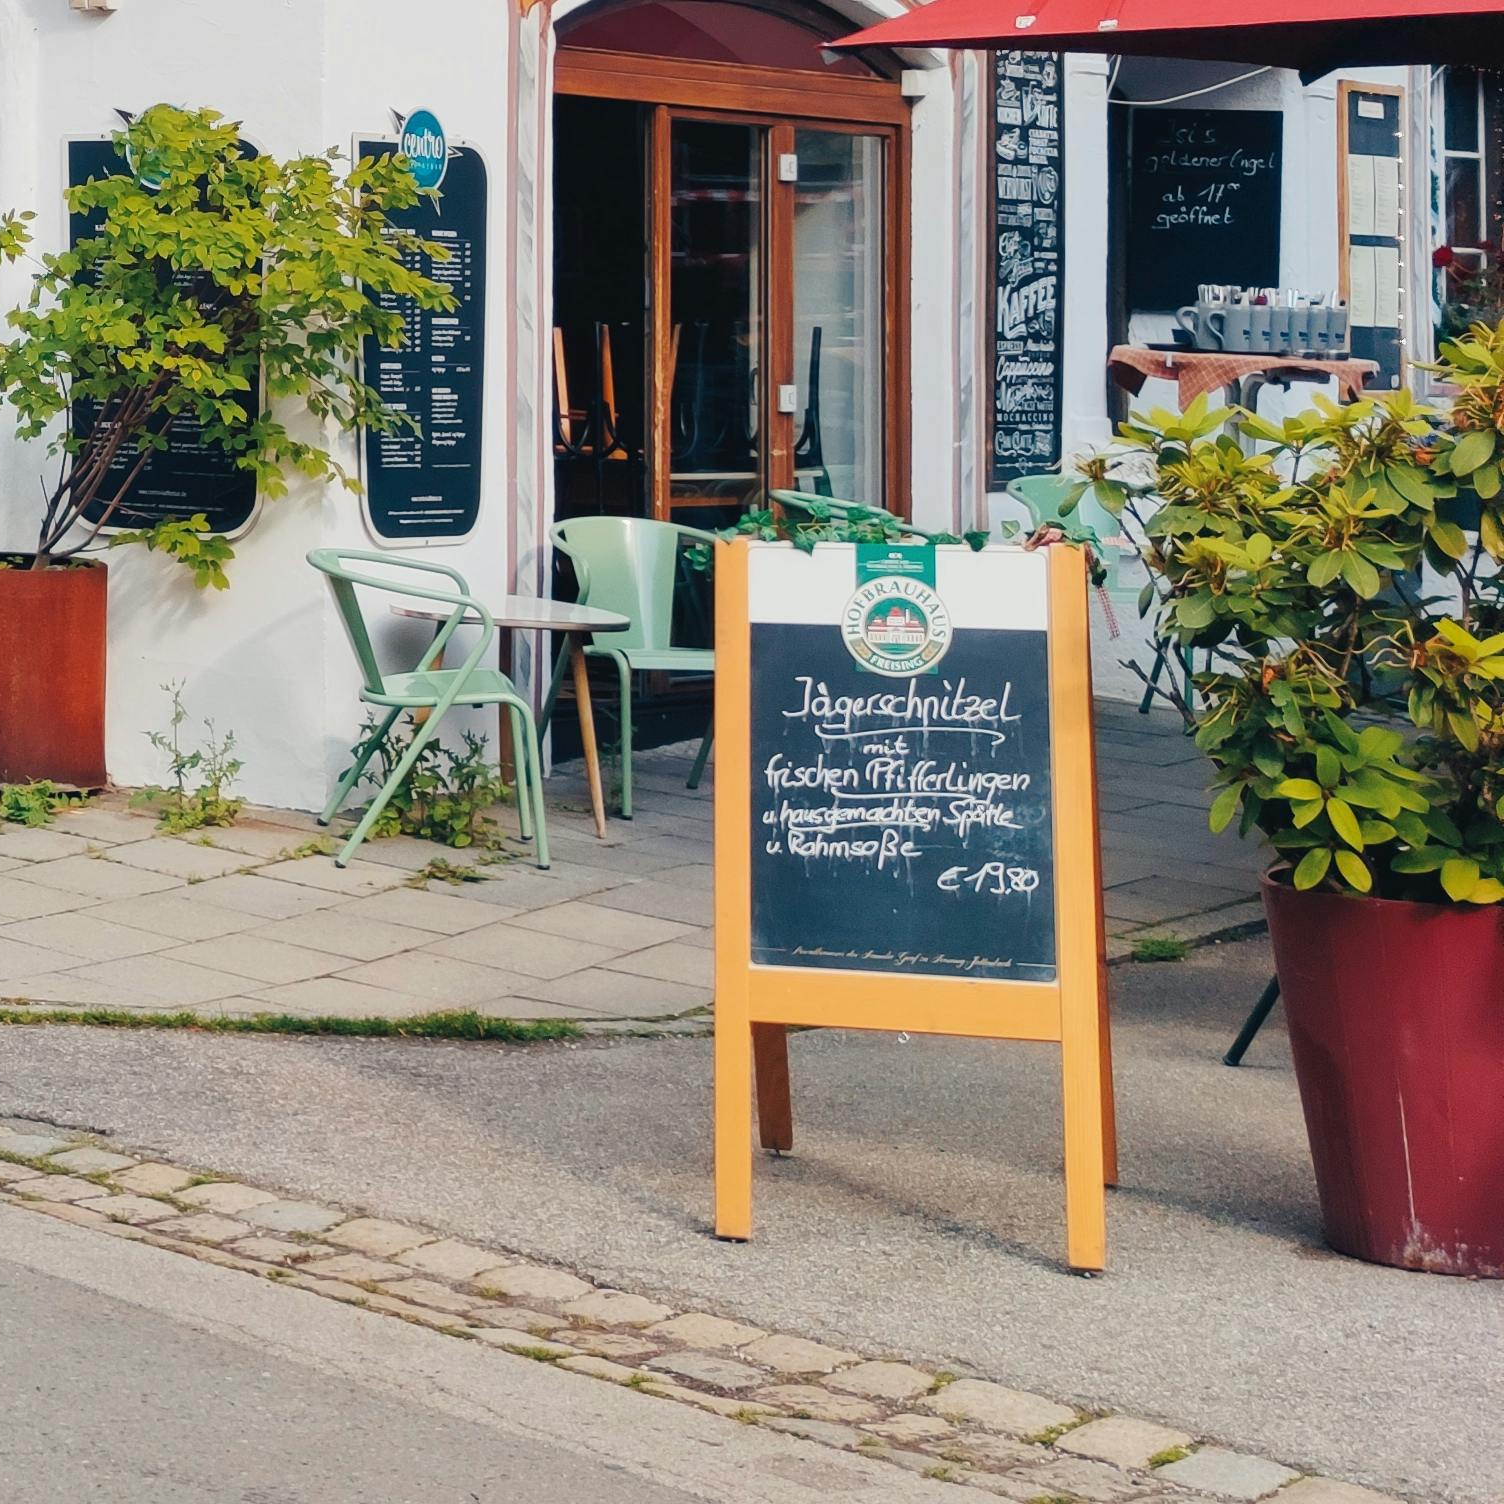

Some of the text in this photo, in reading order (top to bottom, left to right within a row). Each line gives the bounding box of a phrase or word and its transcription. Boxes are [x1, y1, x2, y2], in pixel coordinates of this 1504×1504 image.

[1161, 185, 1185, 202] ab
[996, 276, 1056, 340] KAFFEE
[870, 654, 924, 671] FREISING
[782, 676, 1022, 730] Jägerschnitzel
[863, 735, 910, 754] mit
[764, 753, 1030, 798] frischen Pfifferlingen
[780, 799, 941, 832] hausgemachten
[765, 829, 923, 871] u. Rahmsoße
